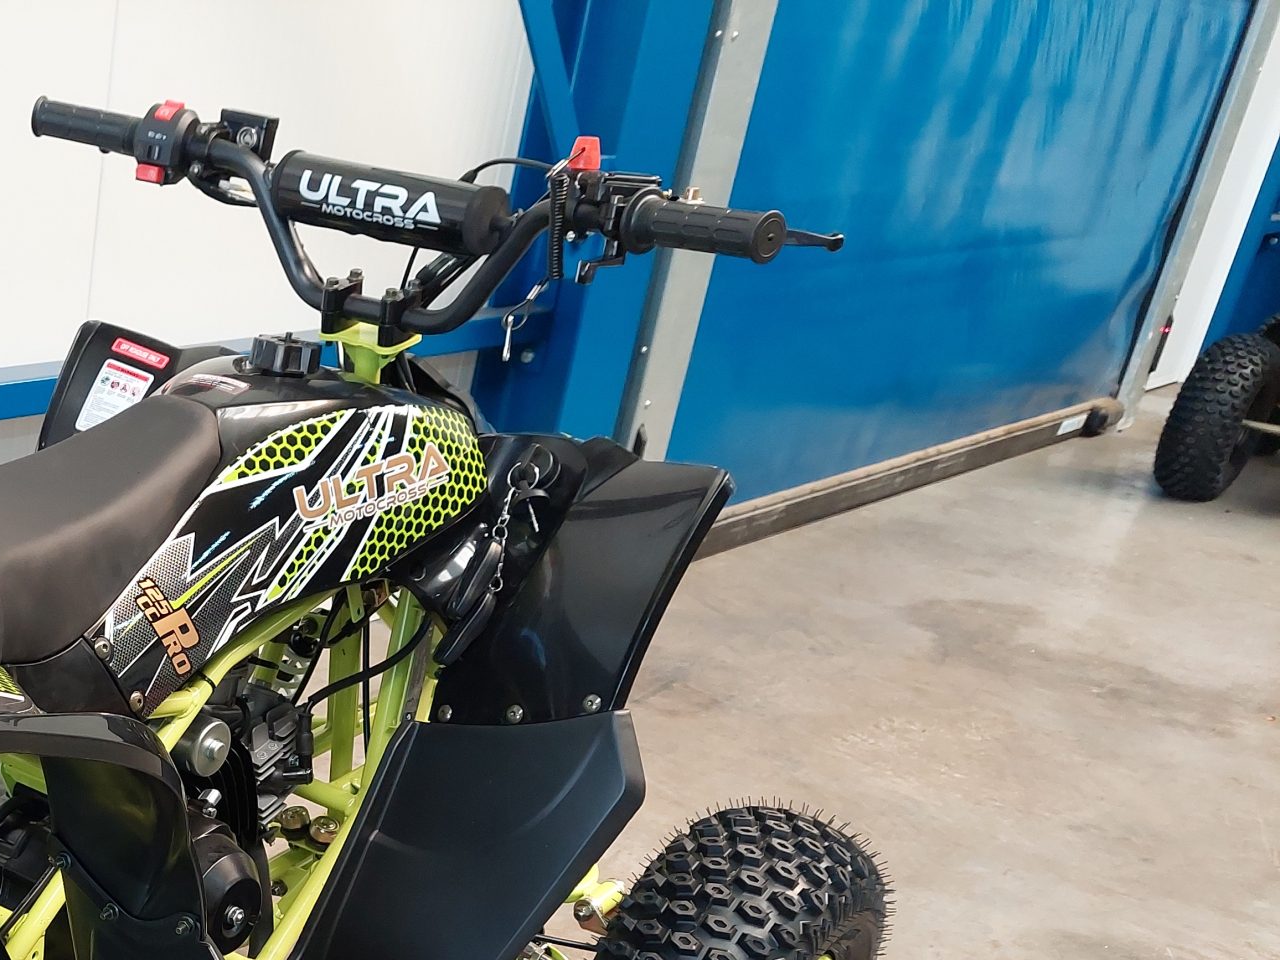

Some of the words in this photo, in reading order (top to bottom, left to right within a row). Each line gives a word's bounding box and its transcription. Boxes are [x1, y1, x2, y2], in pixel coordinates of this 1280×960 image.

[299, 169, 441, 224] ULTRA
[321, 202, 416, 230] MOTOCROSS
[293, 442, 449, 520] ULTRA
[328, 483, 428, 530] MOTOCROSS
[138, 577, 174, 615] 125
